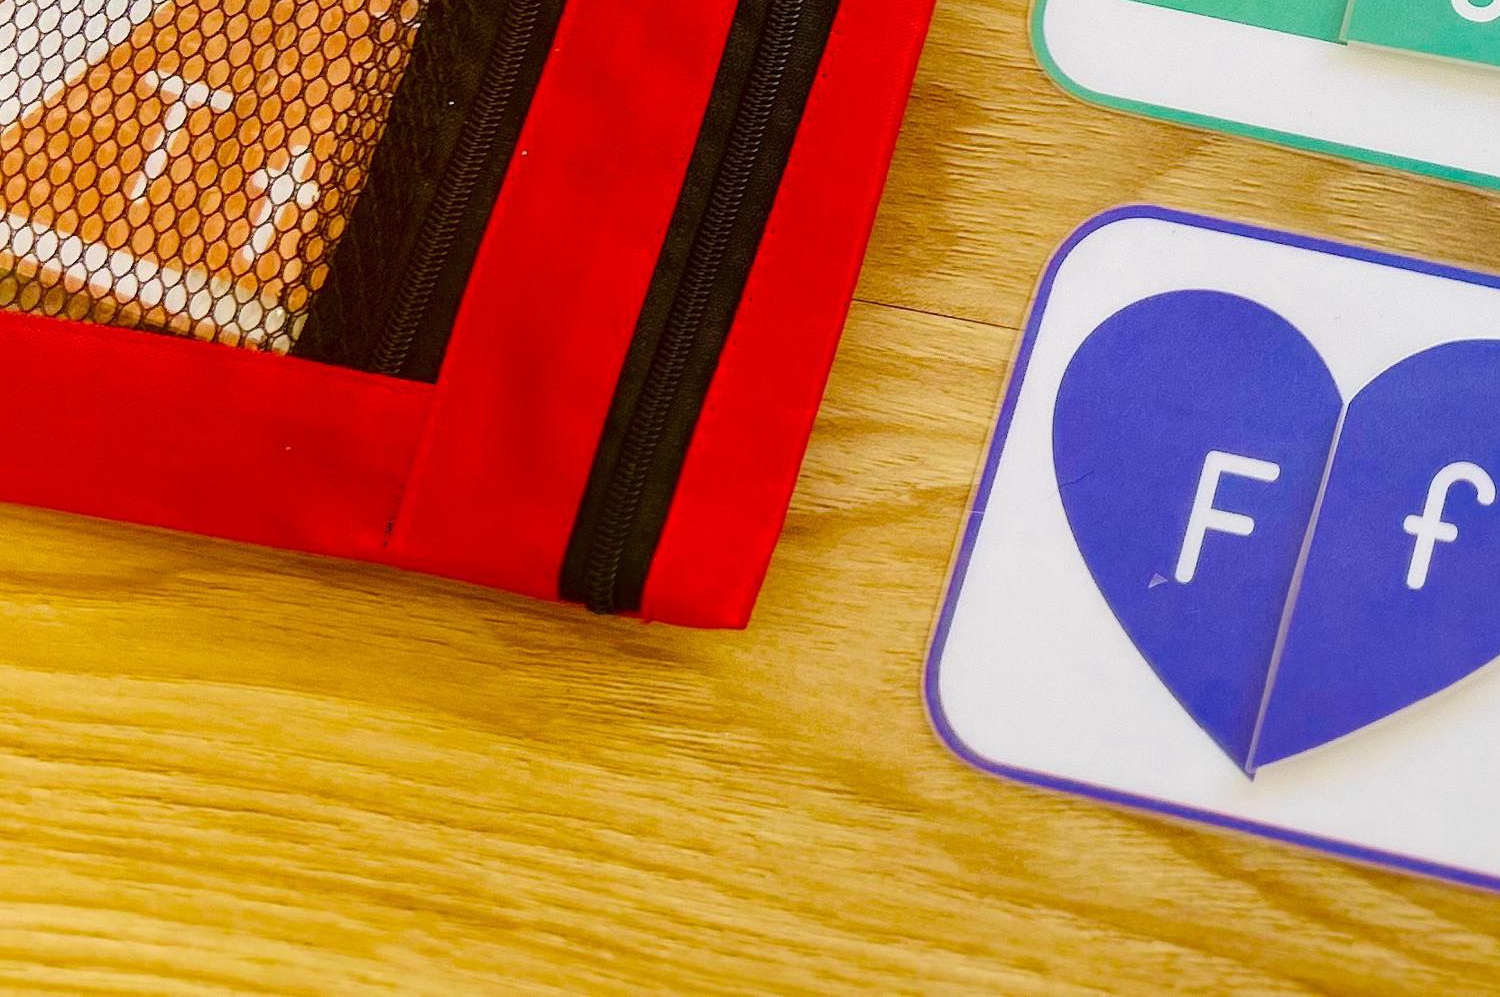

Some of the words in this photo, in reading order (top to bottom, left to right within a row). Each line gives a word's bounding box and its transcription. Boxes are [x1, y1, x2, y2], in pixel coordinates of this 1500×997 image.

[131, 69, 234, 206] T
[1174, 450, 1281, 584] F
[1402, 461, 1496, 590] f
